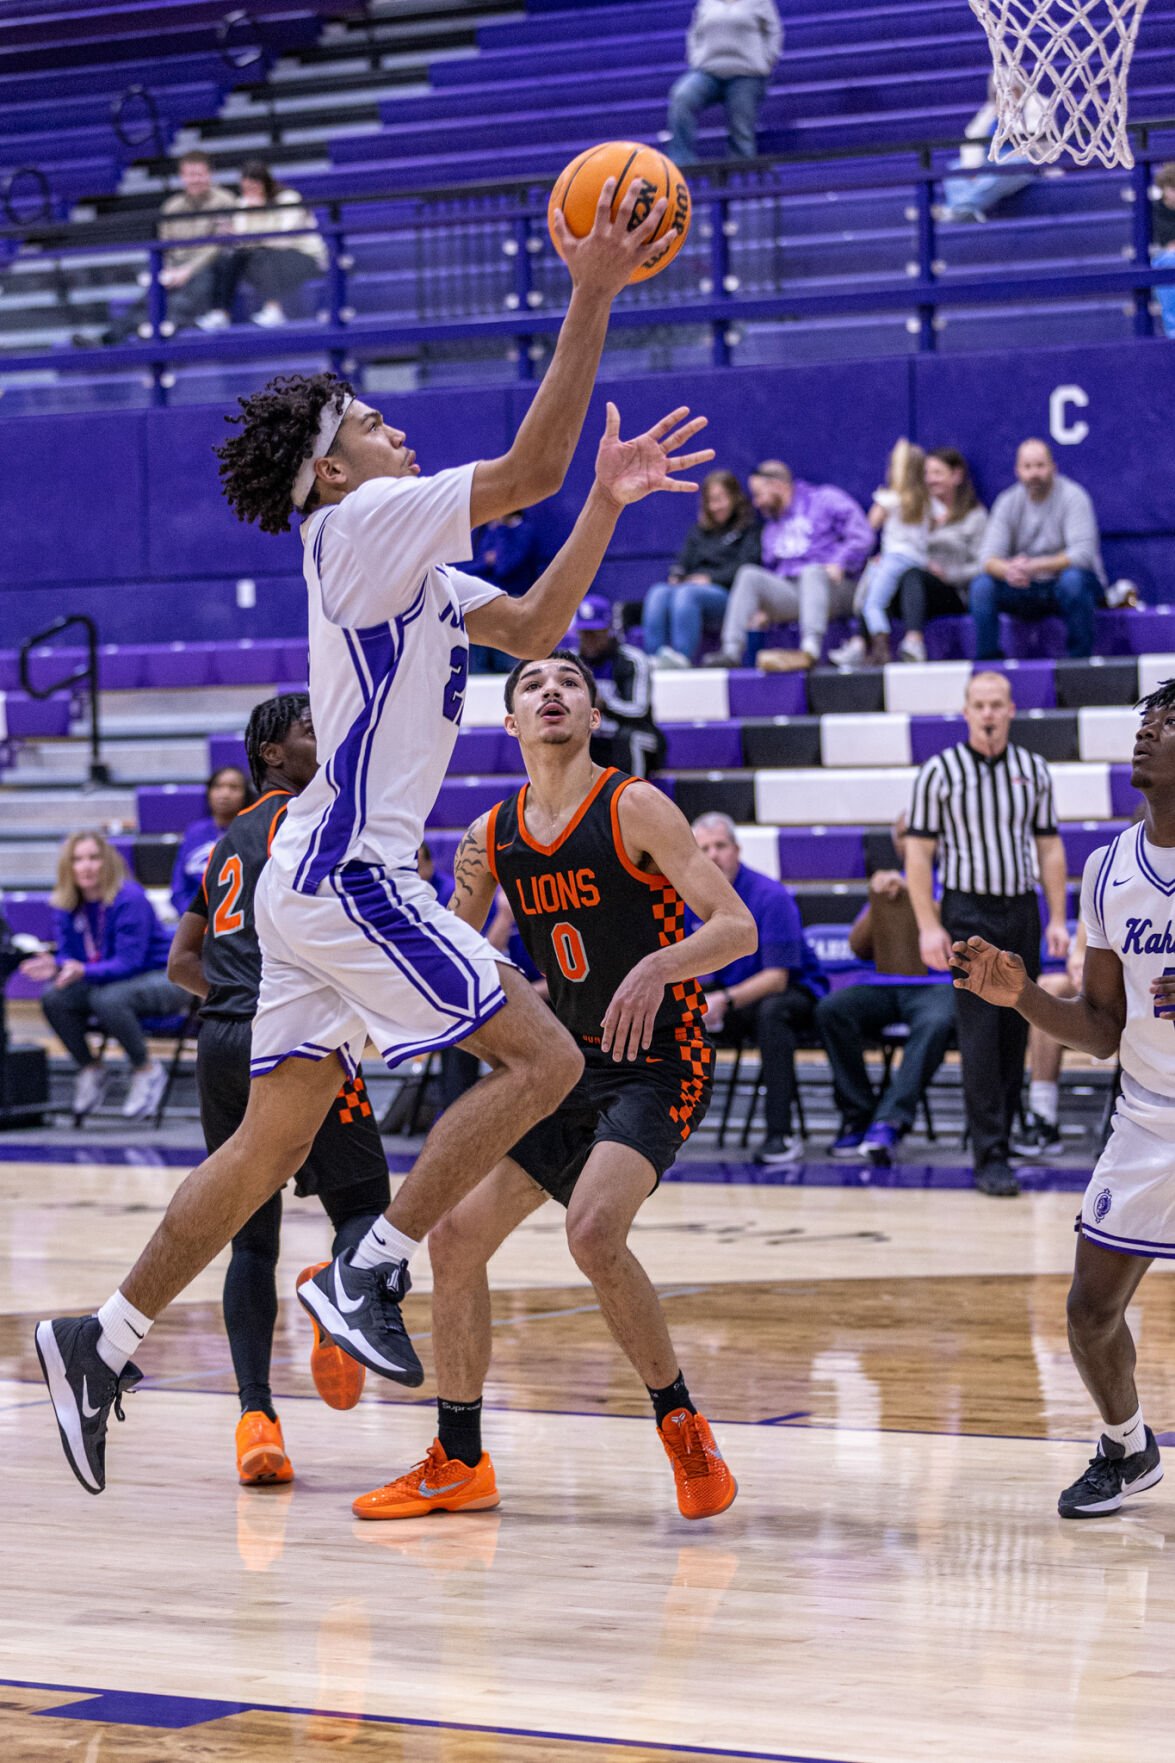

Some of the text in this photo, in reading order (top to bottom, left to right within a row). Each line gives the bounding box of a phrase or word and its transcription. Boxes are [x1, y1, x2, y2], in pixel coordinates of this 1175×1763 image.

[1049, 384, 1089, 446] C
[213, 853, 245, 939] 2
[516, 867, 601, 916] LIONS
[551, 921, 591, 983] 0
